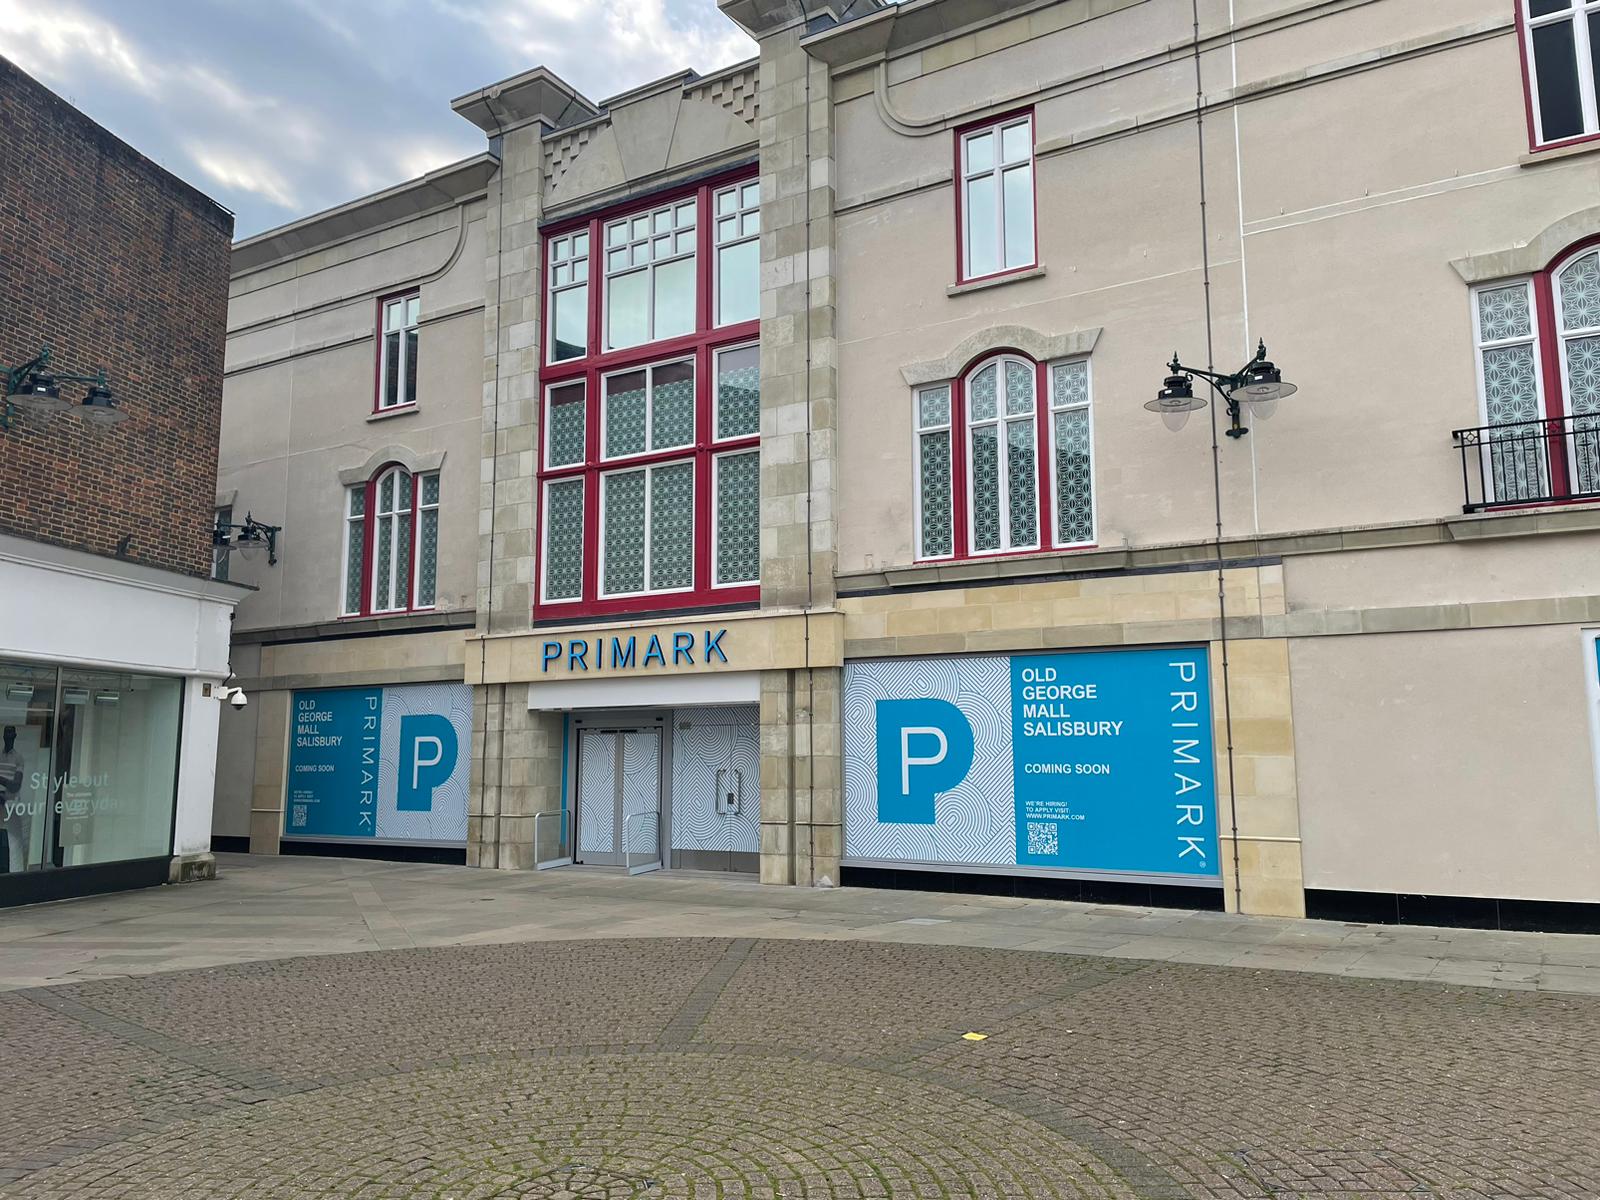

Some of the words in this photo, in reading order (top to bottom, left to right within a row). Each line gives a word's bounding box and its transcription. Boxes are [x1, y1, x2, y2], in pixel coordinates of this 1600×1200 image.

[541, 629, 729, 673] PRIMARK
[1021, 667, 1057, 683] OLD
[1022, 684, 1097, 701] GEORGE
[298, 700, 316, 710] OLD
[1023, 703, 1070, 719] MALL
[298, 711, 333, 723] GEORGE
[297, 724, 320, 735] MALL
[1023, 720, 1124, 737] SALISBURY
[296, 735, 343, 747] SALISBURY
[295, 764, 317, 773] COMING
[318, 764, 335, 772] SOON
[1024, 763, 1072, 775] COMING
[1075, 763, 1111, 775] SOON
[3, 800, 45, 822] your
